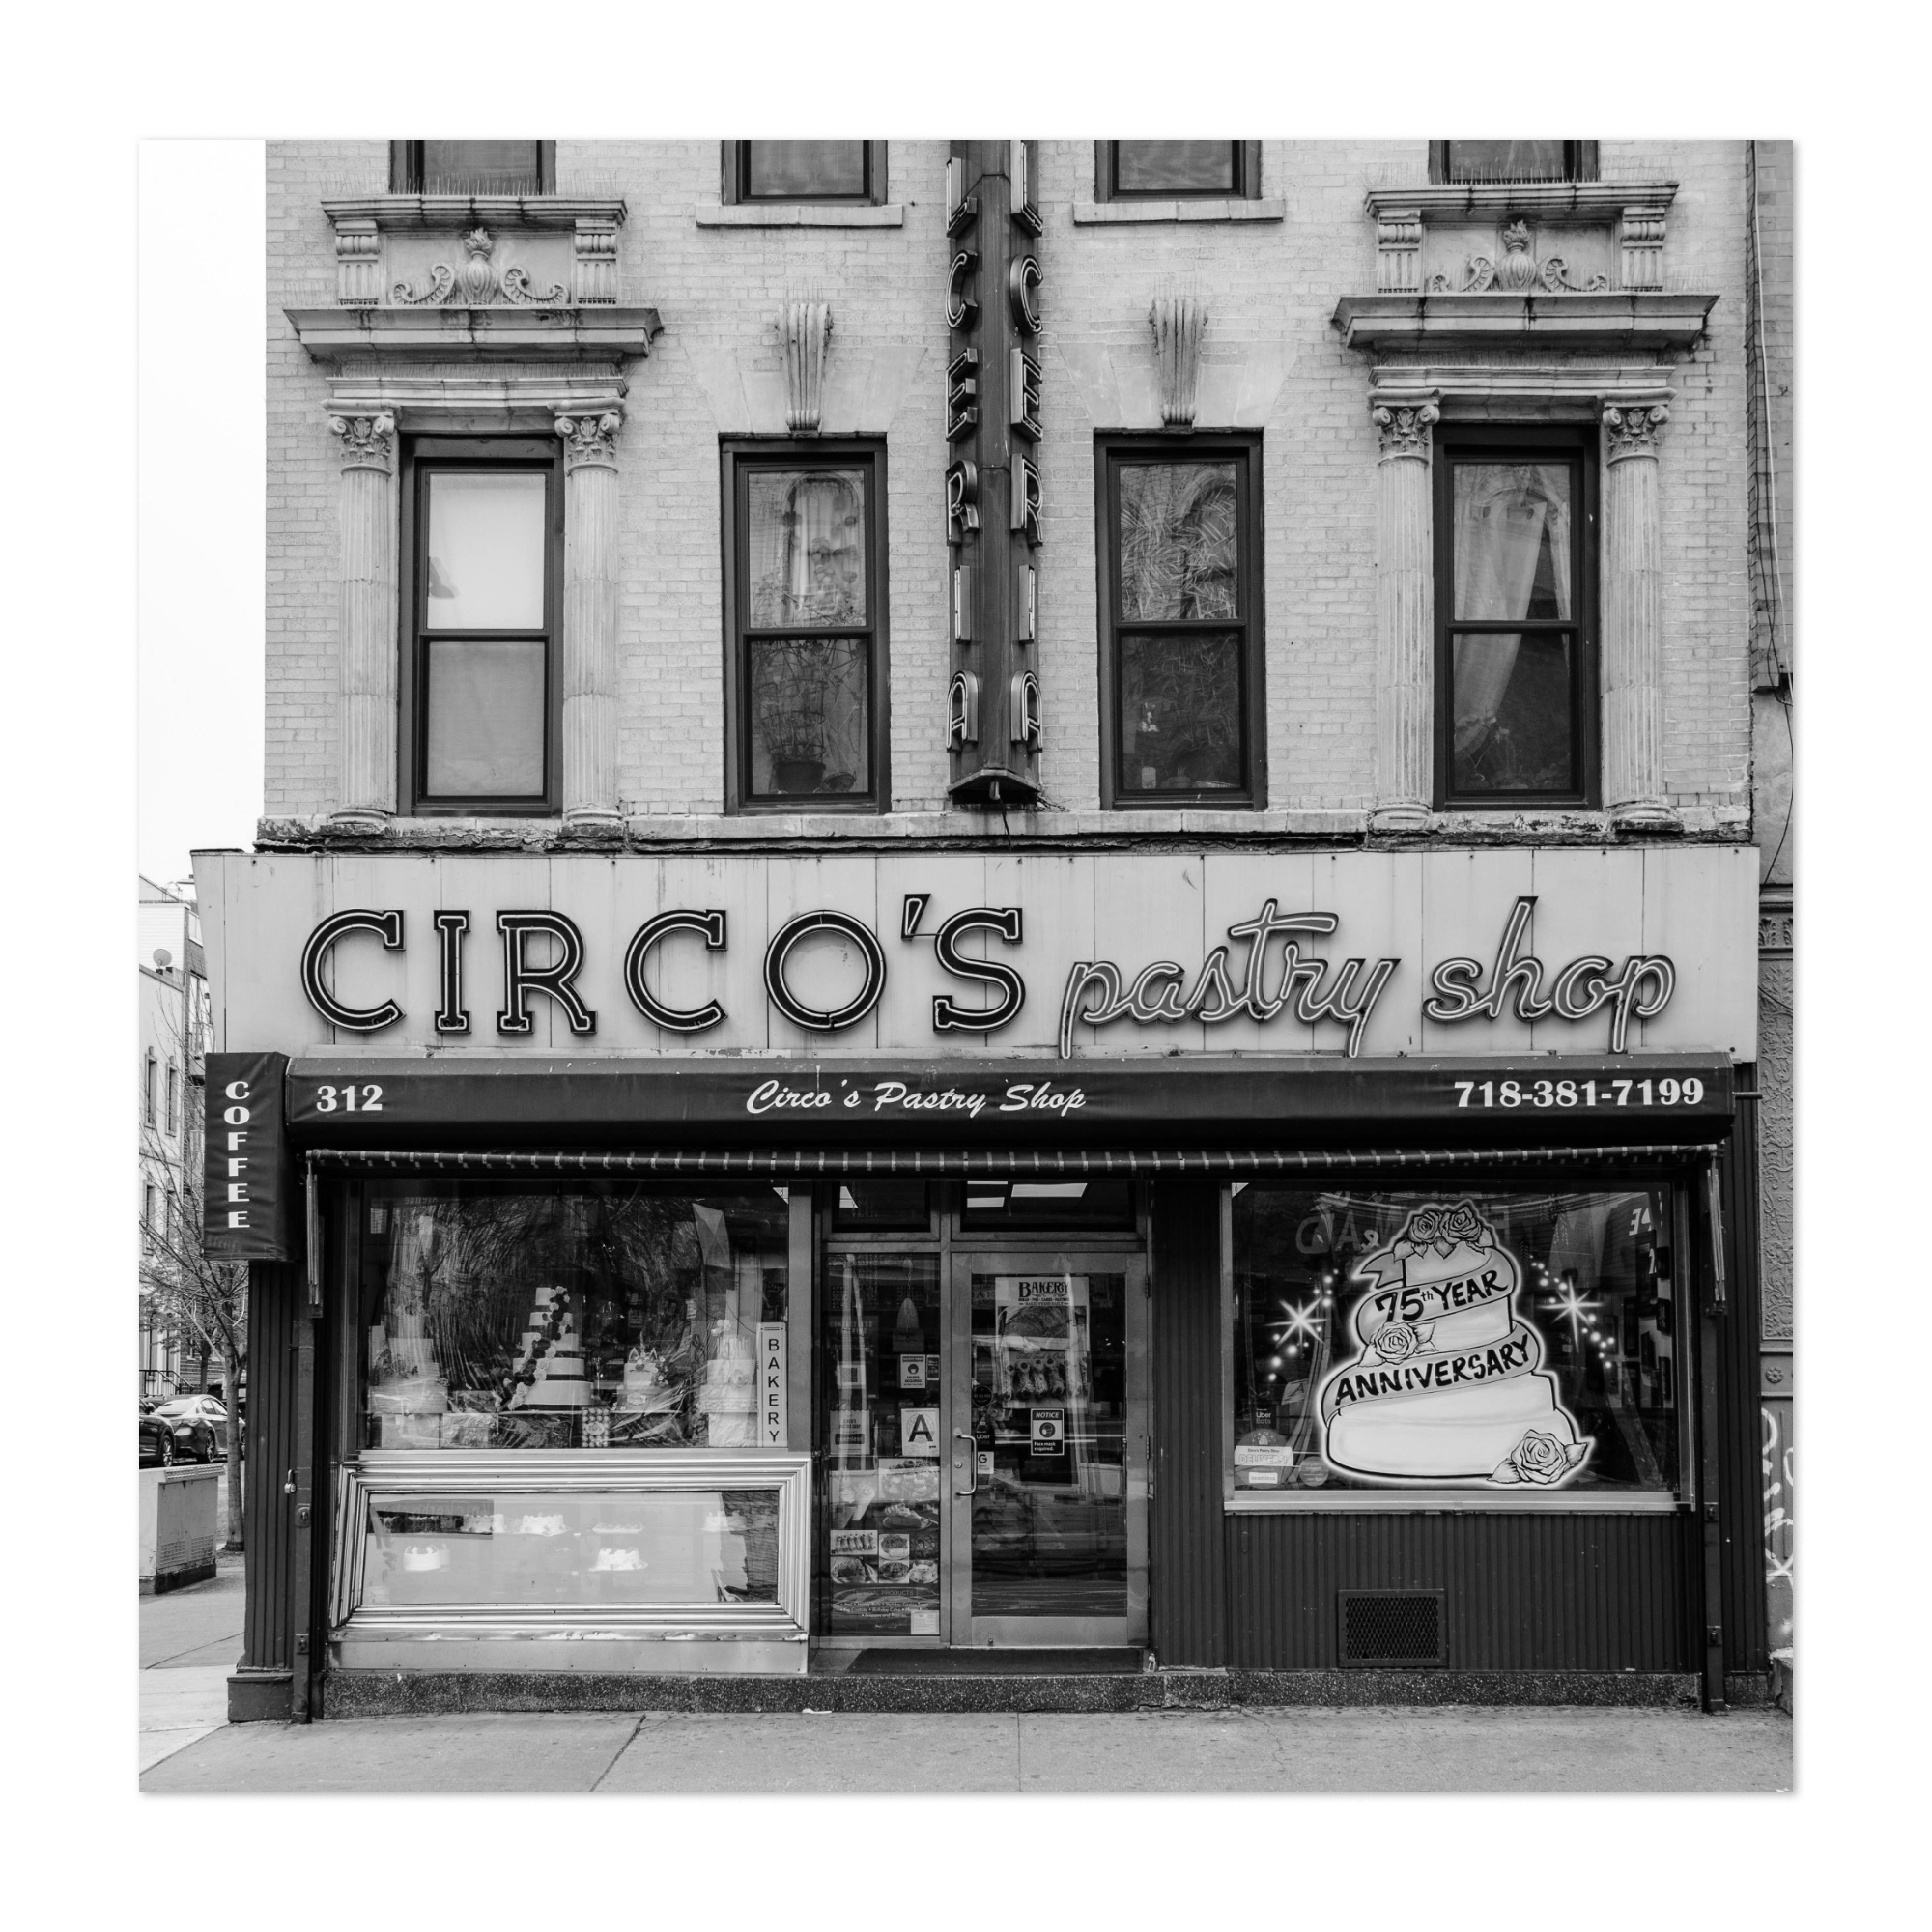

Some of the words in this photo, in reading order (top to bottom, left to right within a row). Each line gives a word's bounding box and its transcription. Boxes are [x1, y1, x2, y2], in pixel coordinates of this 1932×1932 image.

[300, 894, 1026, 1033] CIRCO'S
[1059, 898, 1401, 1058] pastry
[1421, 895, 1676, 1055] shop
[316, 1085, 384, 1112] 312
[746, 1079, 861, 1114] Circo's
[874, 1081, 986, 1118] Pastry
[999, 1082, 1087, 1117] Shop
[1454, 1078, 1705, 1109] 718-381-7199
[224, 1081, 251, 1228] COFFEE
[1018, 1281, 1069, 1297] BAKERY
[1431, 1270, 1508, 1311] YEAR
[1335, 1333, 1528, 1406] ANNIVERSARY
[767, 1338, 780, 1443] BAKERY
[908, 1414, 934, 1442] A
[1239, 1454, 1288, 1464] DELIVERS!
